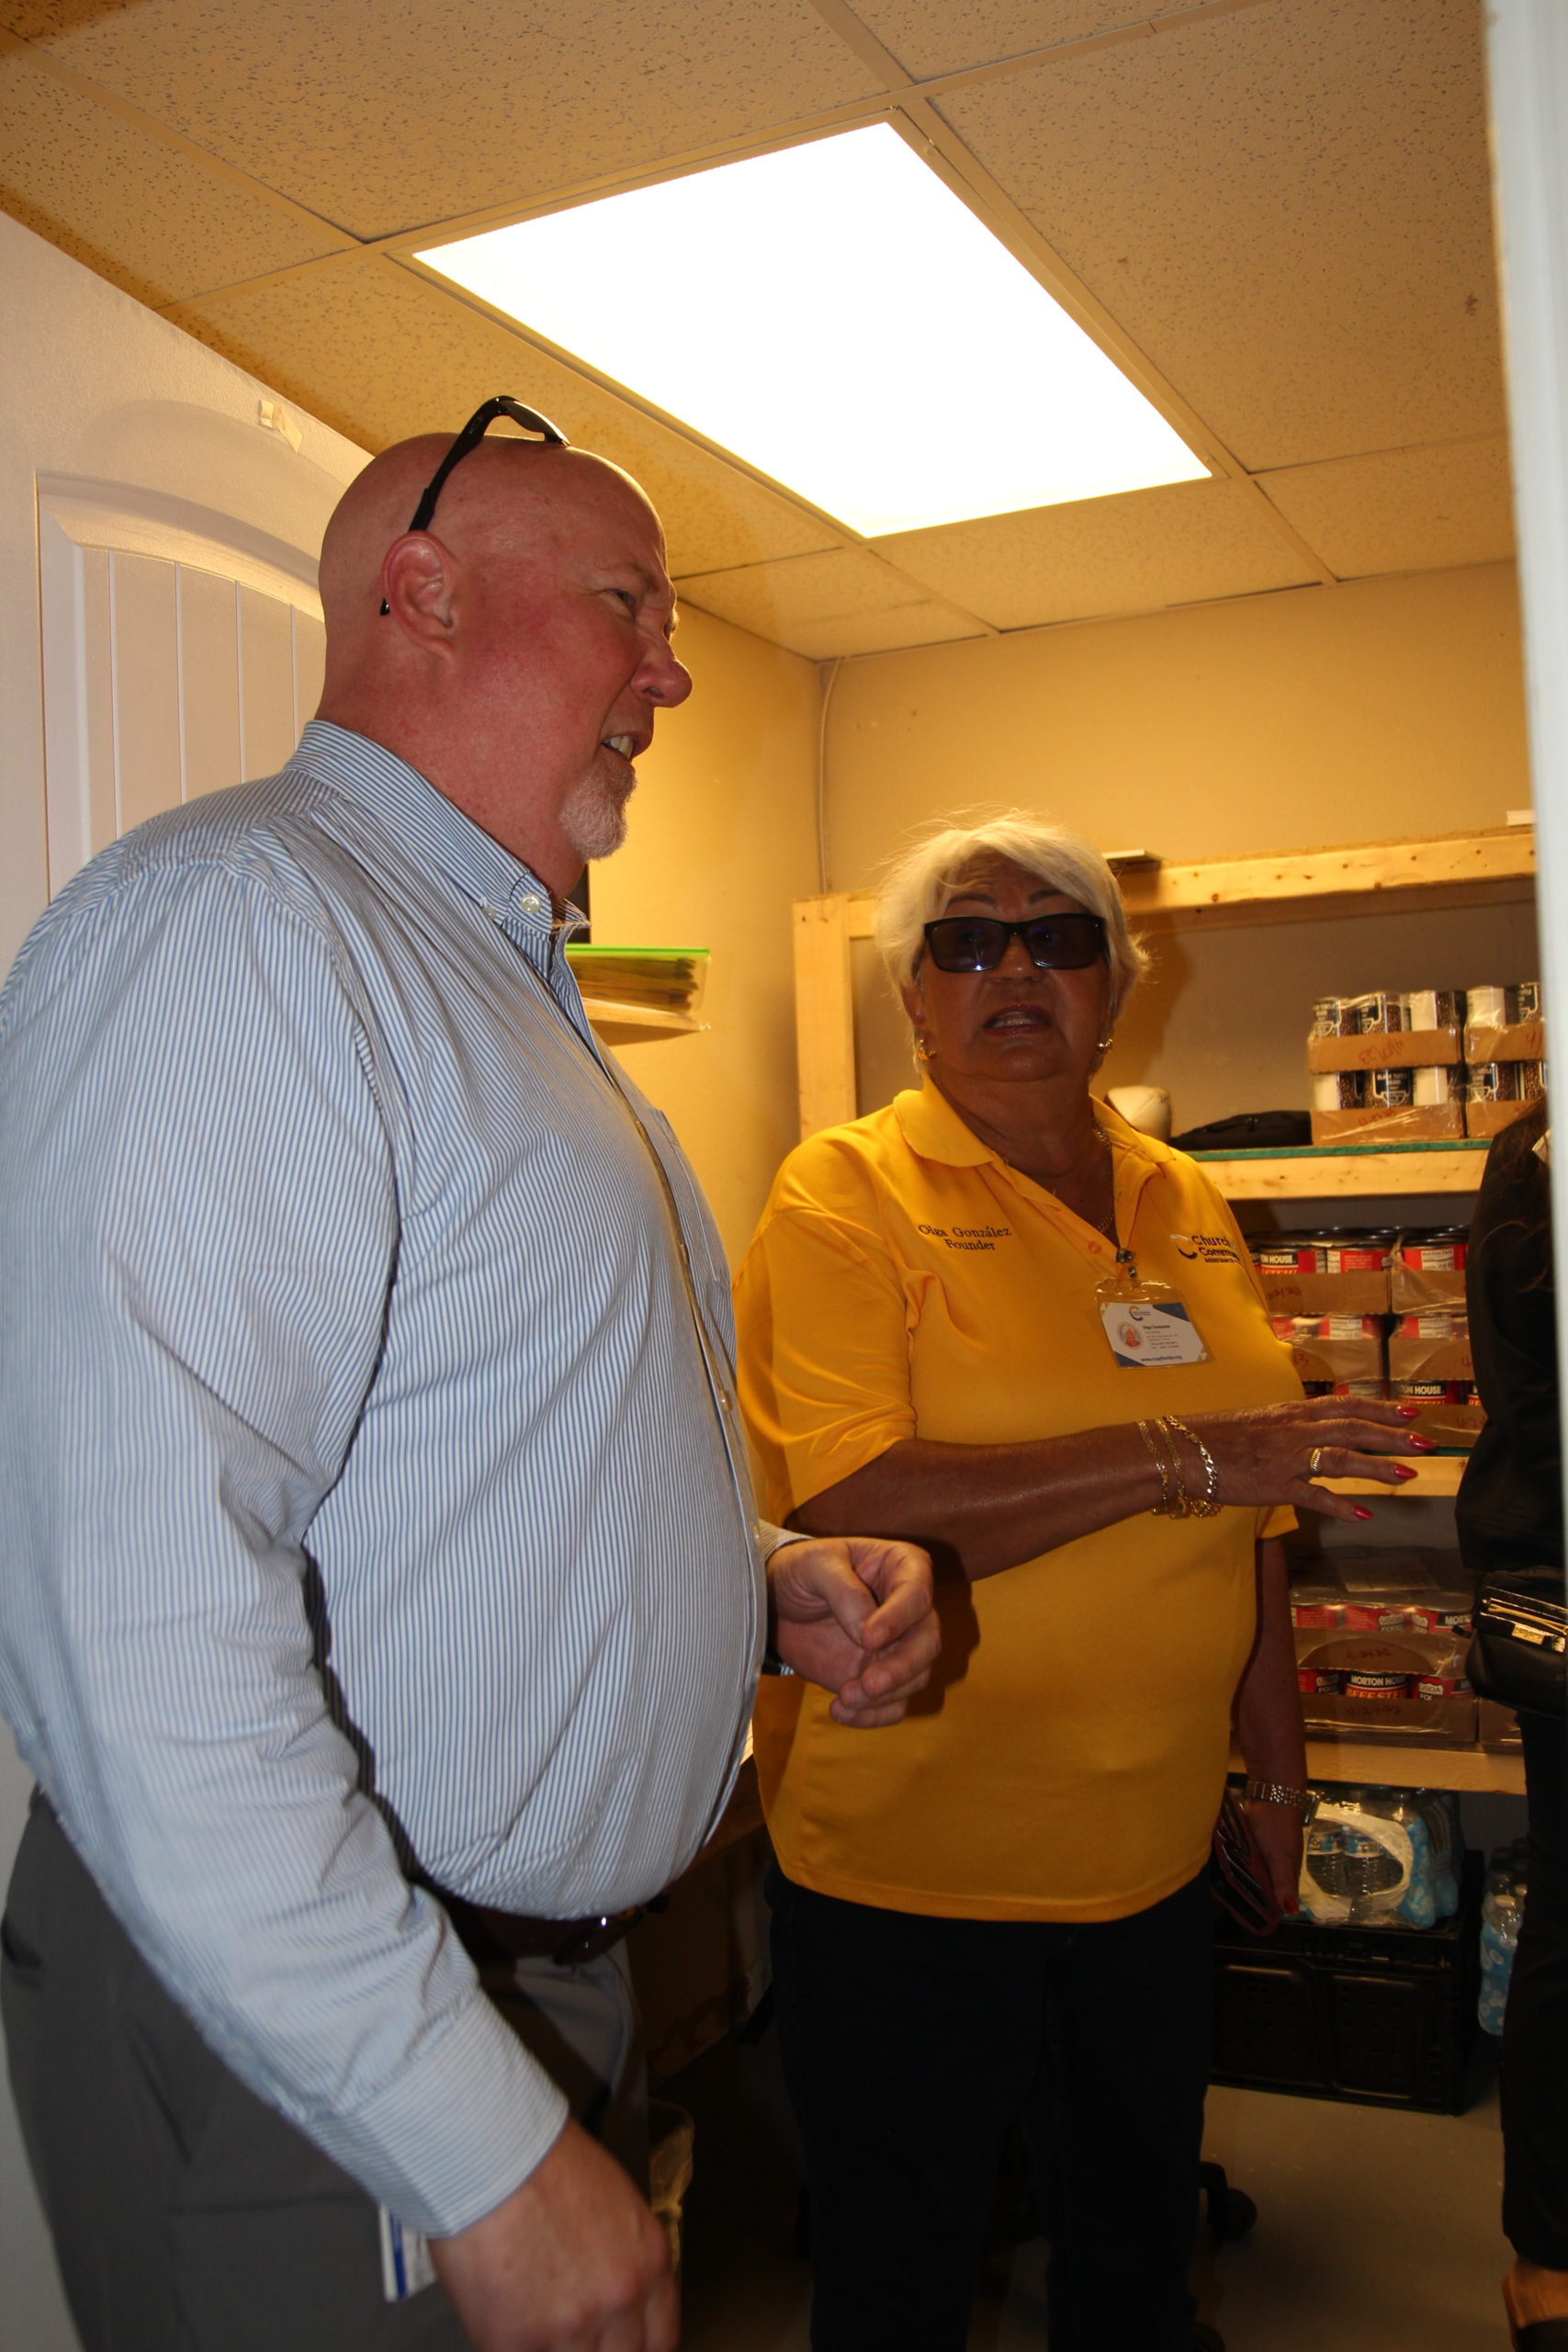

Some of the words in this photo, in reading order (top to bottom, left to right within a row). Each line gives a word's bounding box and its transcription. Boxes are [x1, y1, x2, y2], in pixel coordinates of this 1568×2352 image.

[918, 1225, 948, 1237] Olga
[944, 1238, 996, 1250] Founder
[1269, 1254, 1293, 1264] HOUSE
[1415, 1385, 1442, 1395] HOUSE
[1350, 1675, 1384, 1687] MORTON
